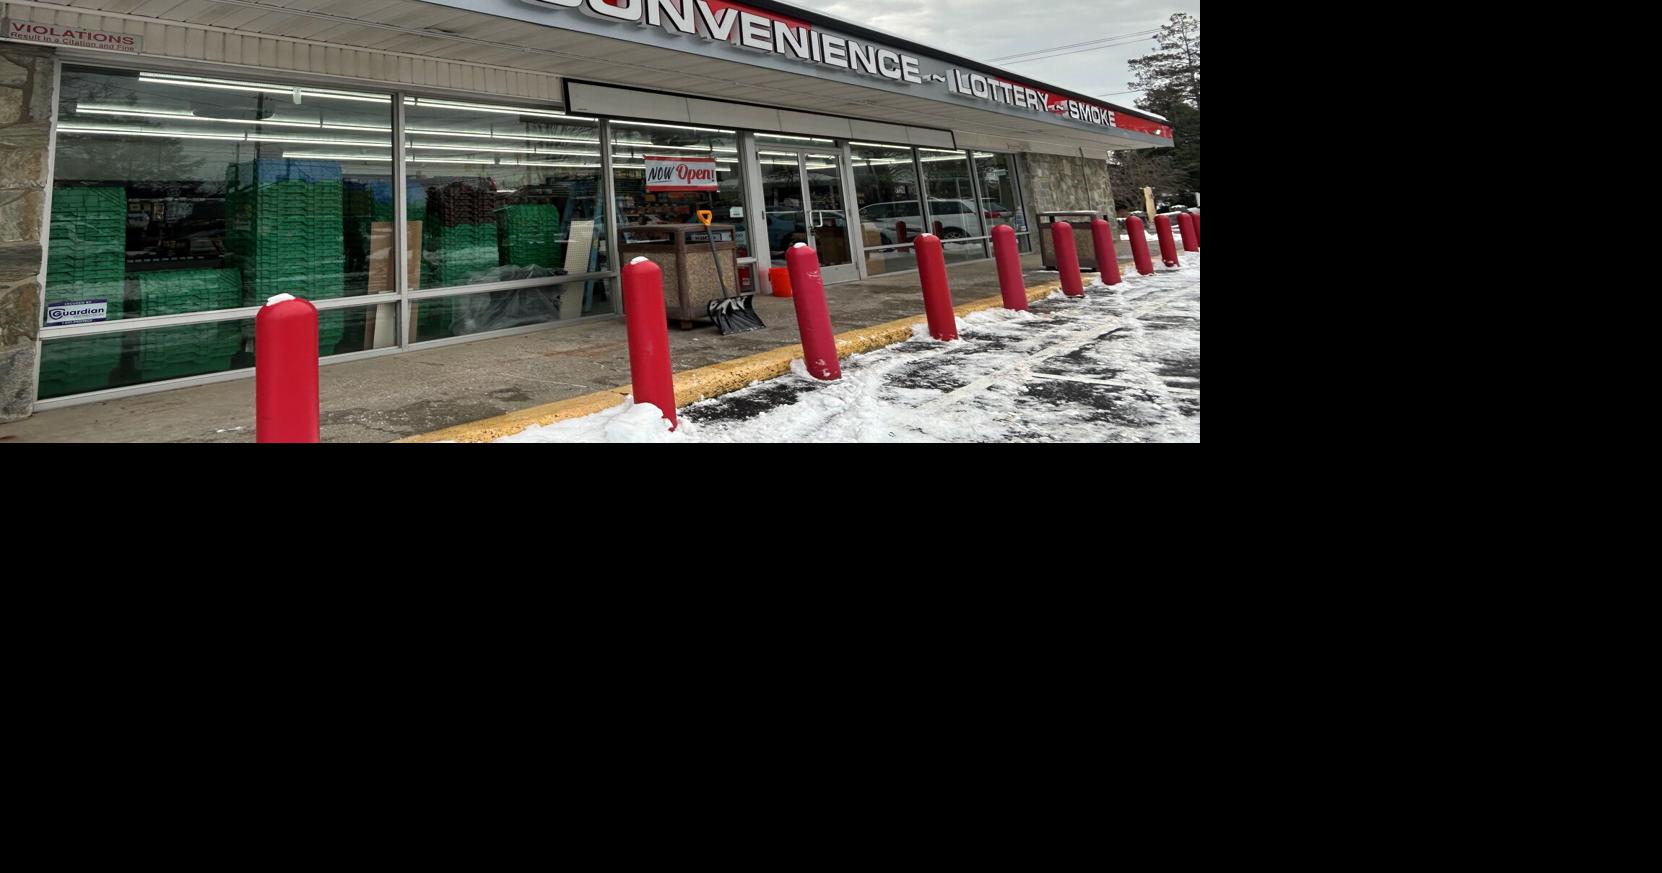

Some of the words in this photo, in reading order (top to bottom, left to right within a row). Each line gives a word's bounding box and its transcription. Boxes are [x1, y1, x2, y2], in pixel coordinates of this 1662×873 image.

[11, 31, 41, 41] Result
[62, 37, 96, 48] Citation
[12, 22, 135, 46] VIOLATIONS
[538, 0, 922, 84] NVENIENCE
[953, 69, 1049, 112] LOTTERY
[1069, 100, 1117, 127] SMOKE
[648, 166, 675, 182] NOW
[49, 308, 105, 320] Guardian
